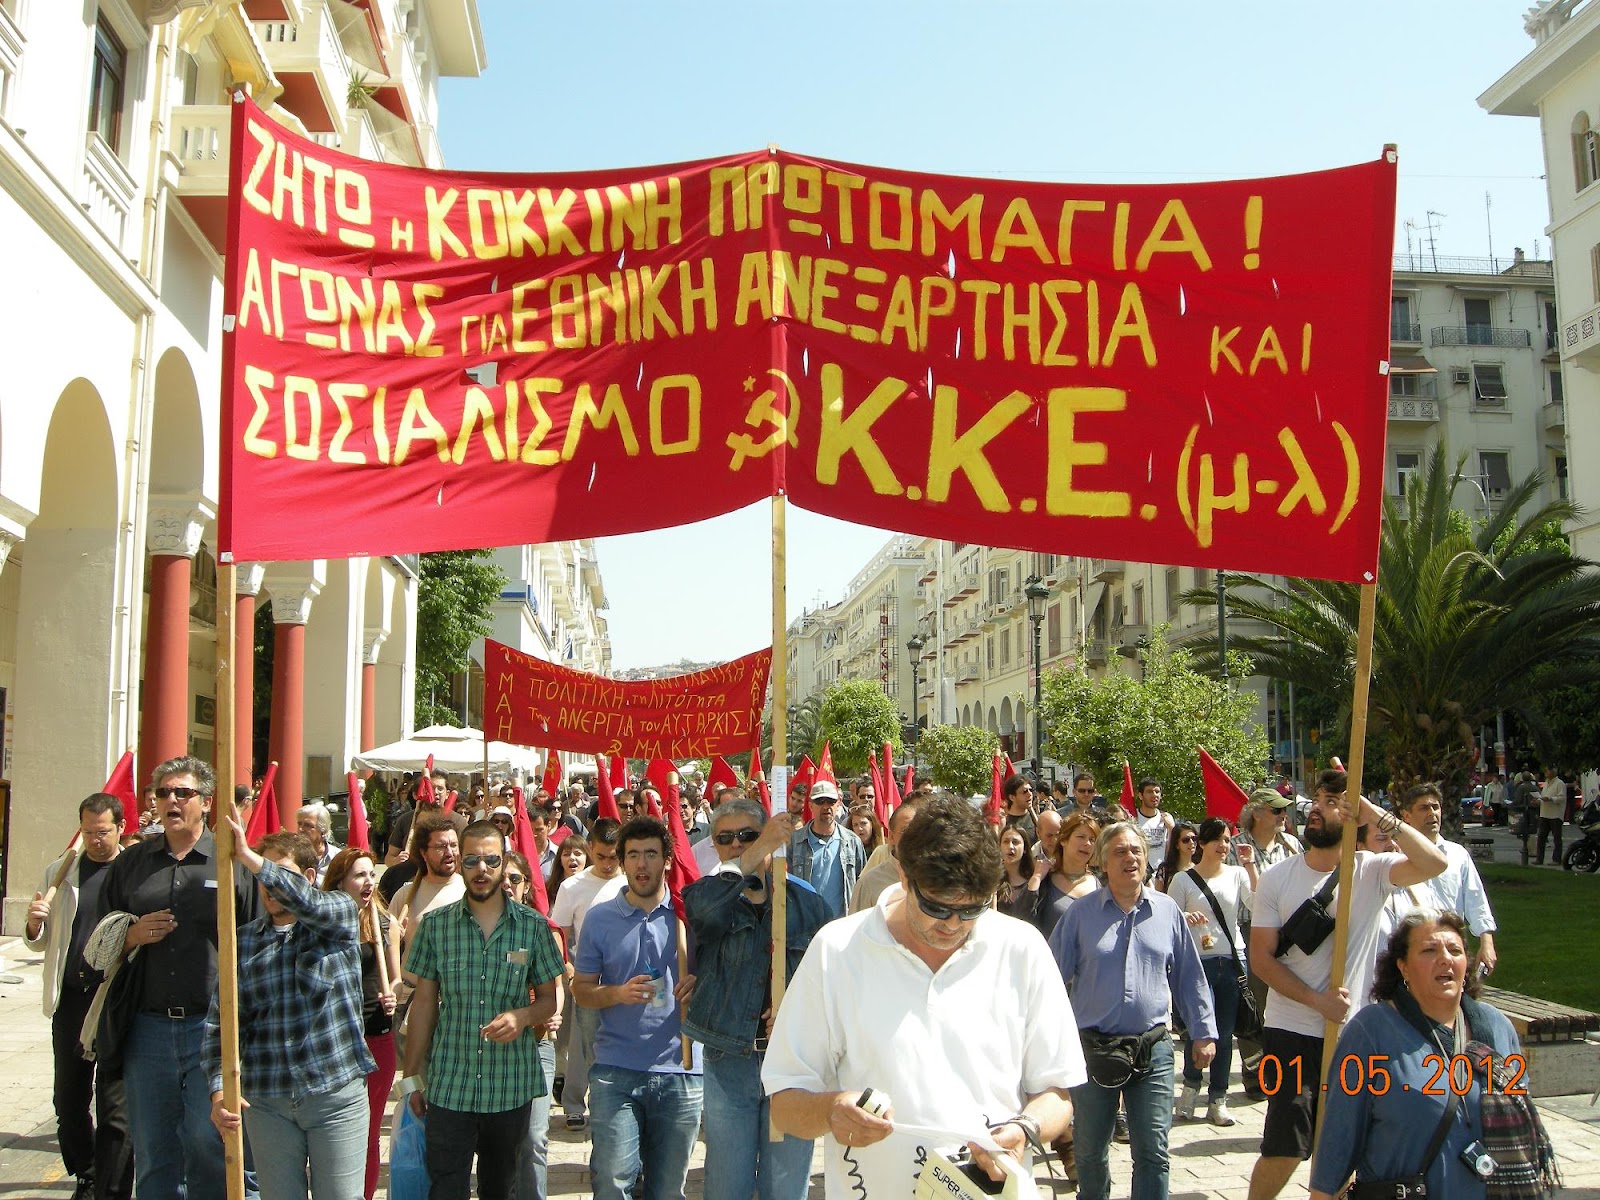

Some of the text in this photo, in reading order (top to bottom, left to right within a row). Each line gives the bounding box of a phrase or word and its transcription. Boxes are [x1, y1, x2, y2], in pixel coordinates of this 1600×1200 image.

[241, 119, 375, 249] ΖΗΤΩ
[424, 177, 683, 260] ΚΟΚΚΙΝΗ
[239, 248, 1313, 376] ΑΓΩΝΑΣ ΓΙΑ ΕΘΝΙΚΗ ΑΝΕΞΑΡΤΗΣΙΑ ΚΑΙ
[242, 365, 703, 467] ΣΟΣΙΑΛΙΣΜΟ
[815, 364, 1157, 519] Κ.Κ.Ε.
[529, 678, 624, 708] ΠΟΛΙΤΙΚΗ
[558, 706, 634, 737] ΑΝΕΡΓΙΑ
[671, 736, 722, 758] ΚΚΕ
[932, 1167, 960, 1195] SUPER
